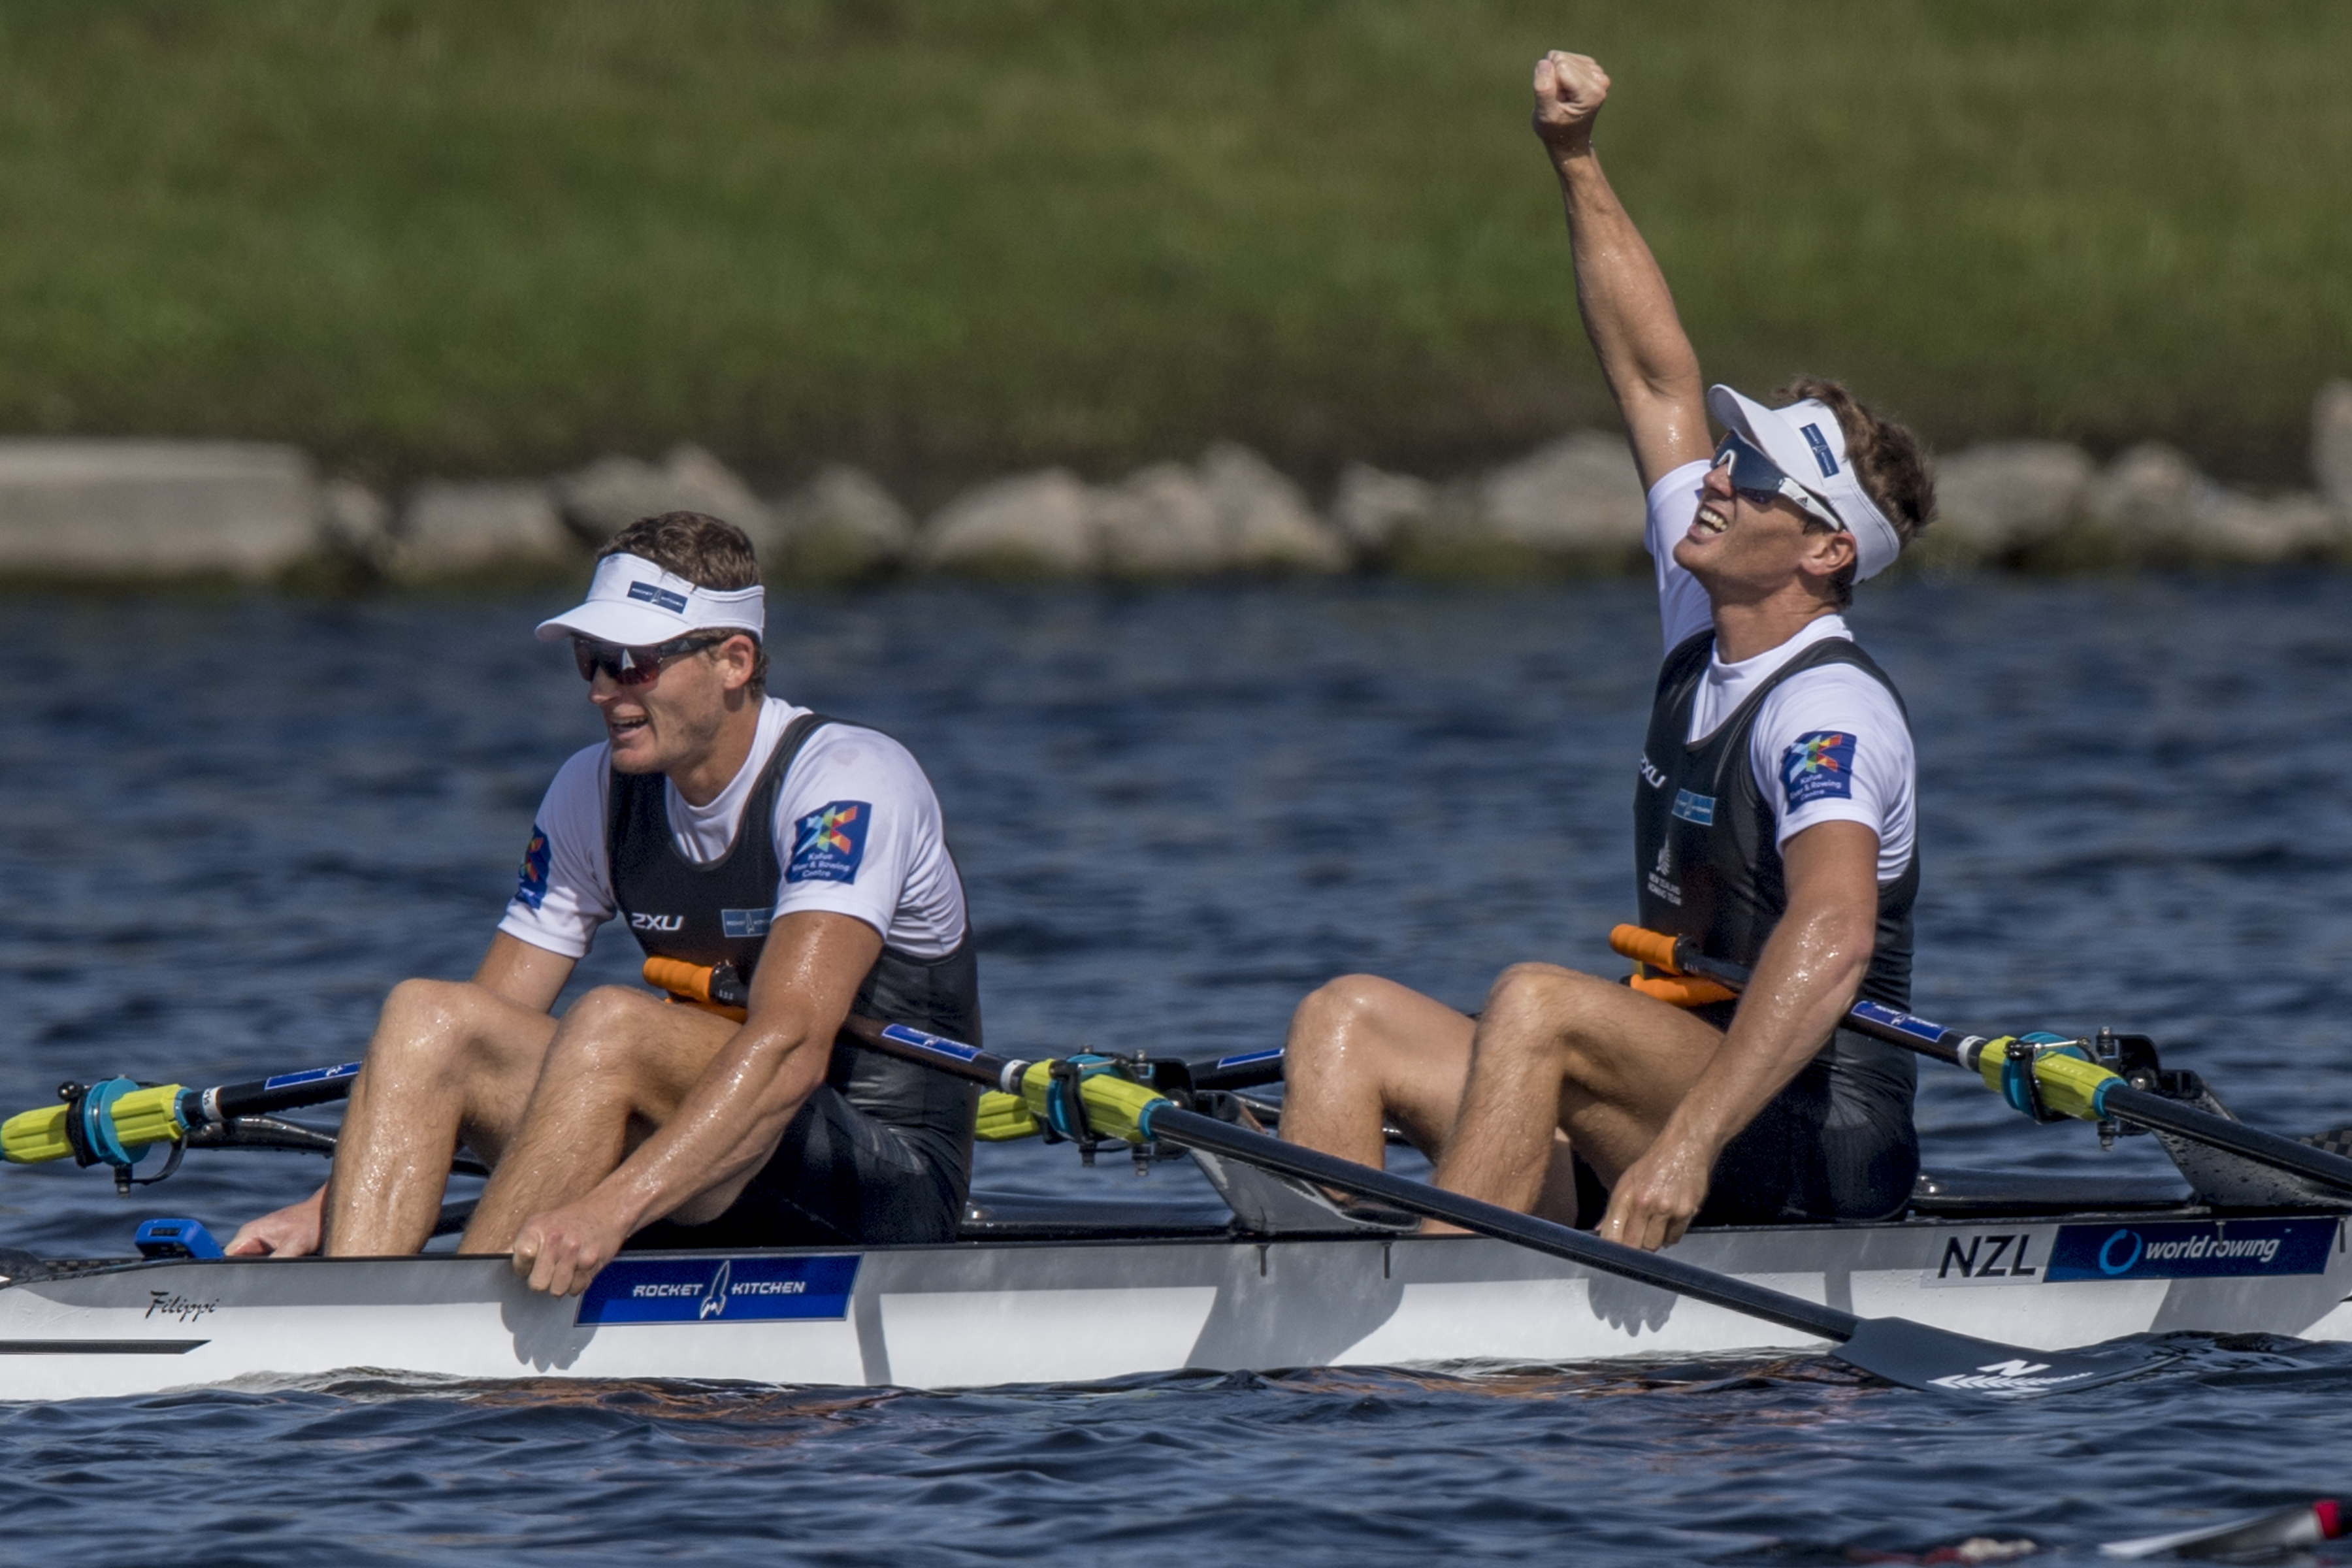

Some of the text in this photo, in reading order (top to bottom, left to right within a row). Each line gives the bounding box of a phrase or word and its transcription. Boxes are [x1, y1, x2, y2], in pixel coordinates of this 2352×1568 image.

[631, 913, 685, 931] 2XU
[1938, 1234, 2036, 1279] NZL
[2146, 1235, 2281, 1262] world rowing
[632, 1281, 807, 1298] ROCKET KITCHEN
[145, 1290, 220, 1322] Filippi
